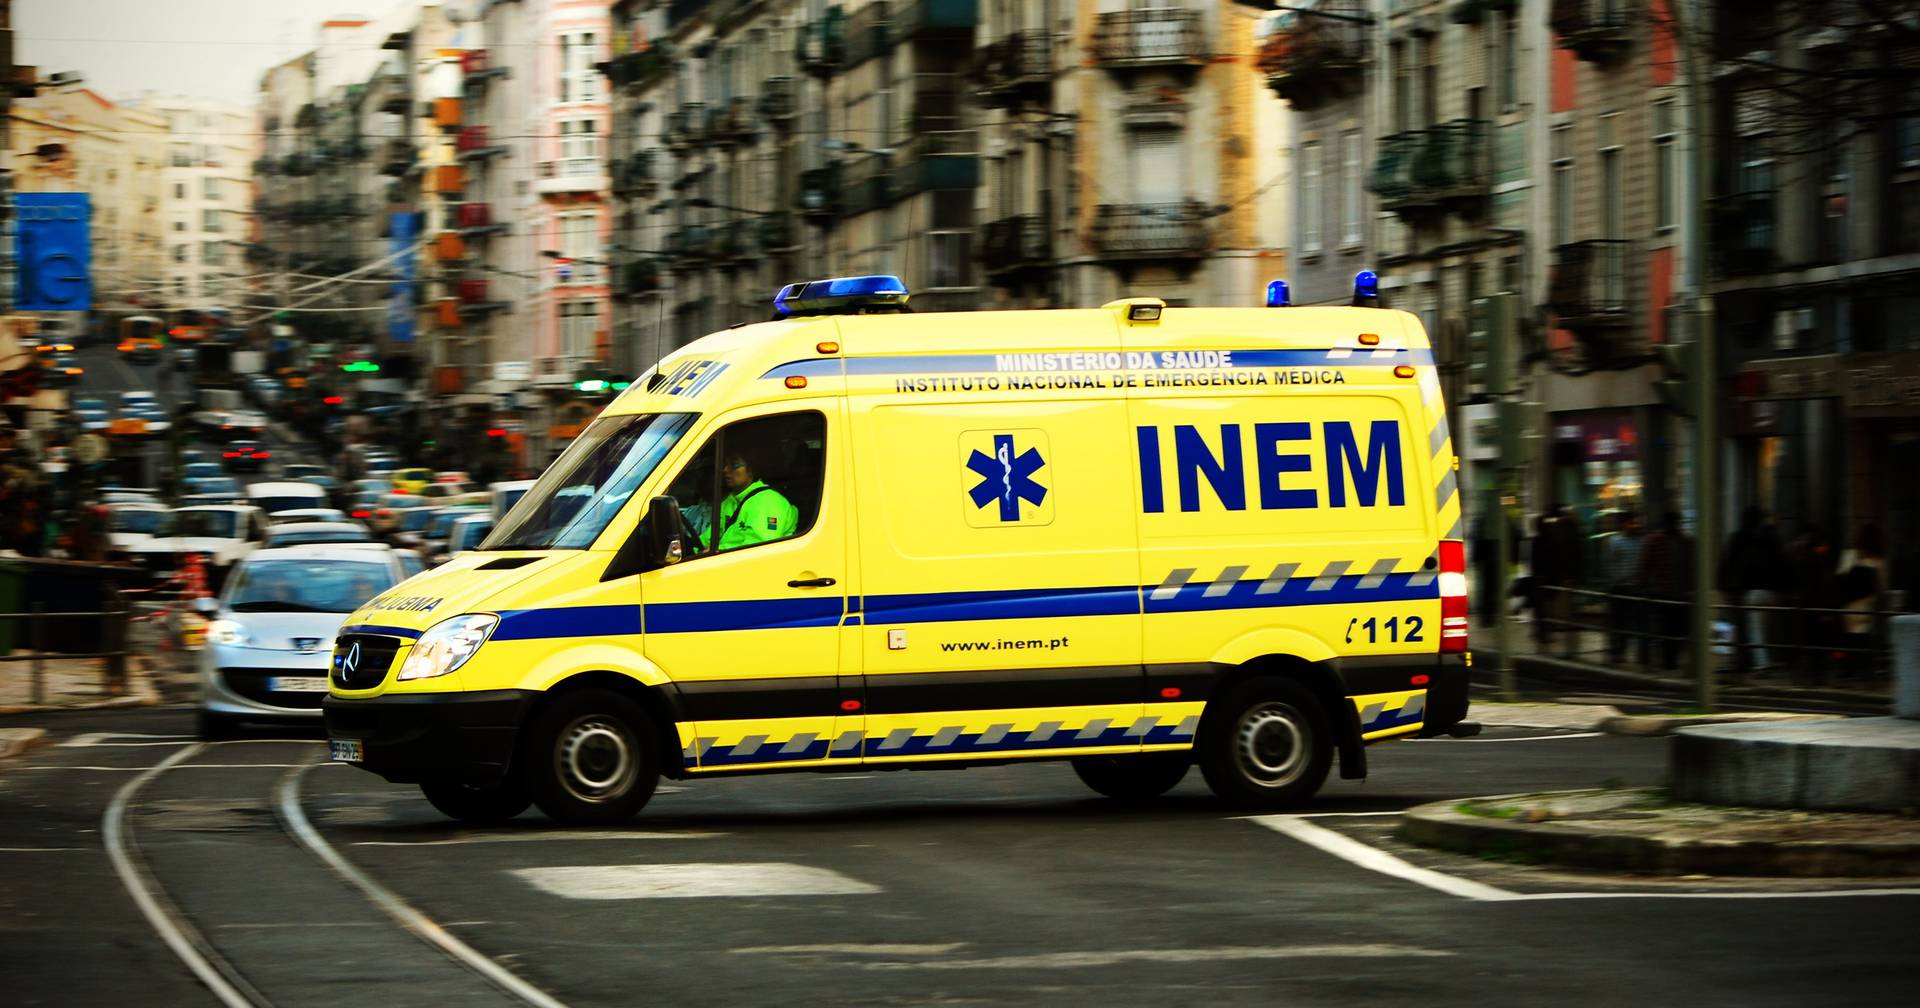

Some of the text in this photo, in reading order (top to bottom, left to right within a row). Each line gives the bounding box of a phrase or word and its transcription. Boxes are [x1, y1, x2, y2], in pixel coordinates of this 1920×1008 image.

[1127, 352, 1158, 370] DA
[648, 360, 732, 399] INEM
[896, 377, 999, 393] INSTITUTO
[1007, 374, 1106, 390] NACIONAL
[1113, 373, 1137, 388] DE
[1144, 370, 1267, 388] EMERGÊNCIA
[1136, 420, 1405, 513] INEM
[1363, 616, 1424, 643] 112
[941, 637, 1069, 652] www.inem.pt
